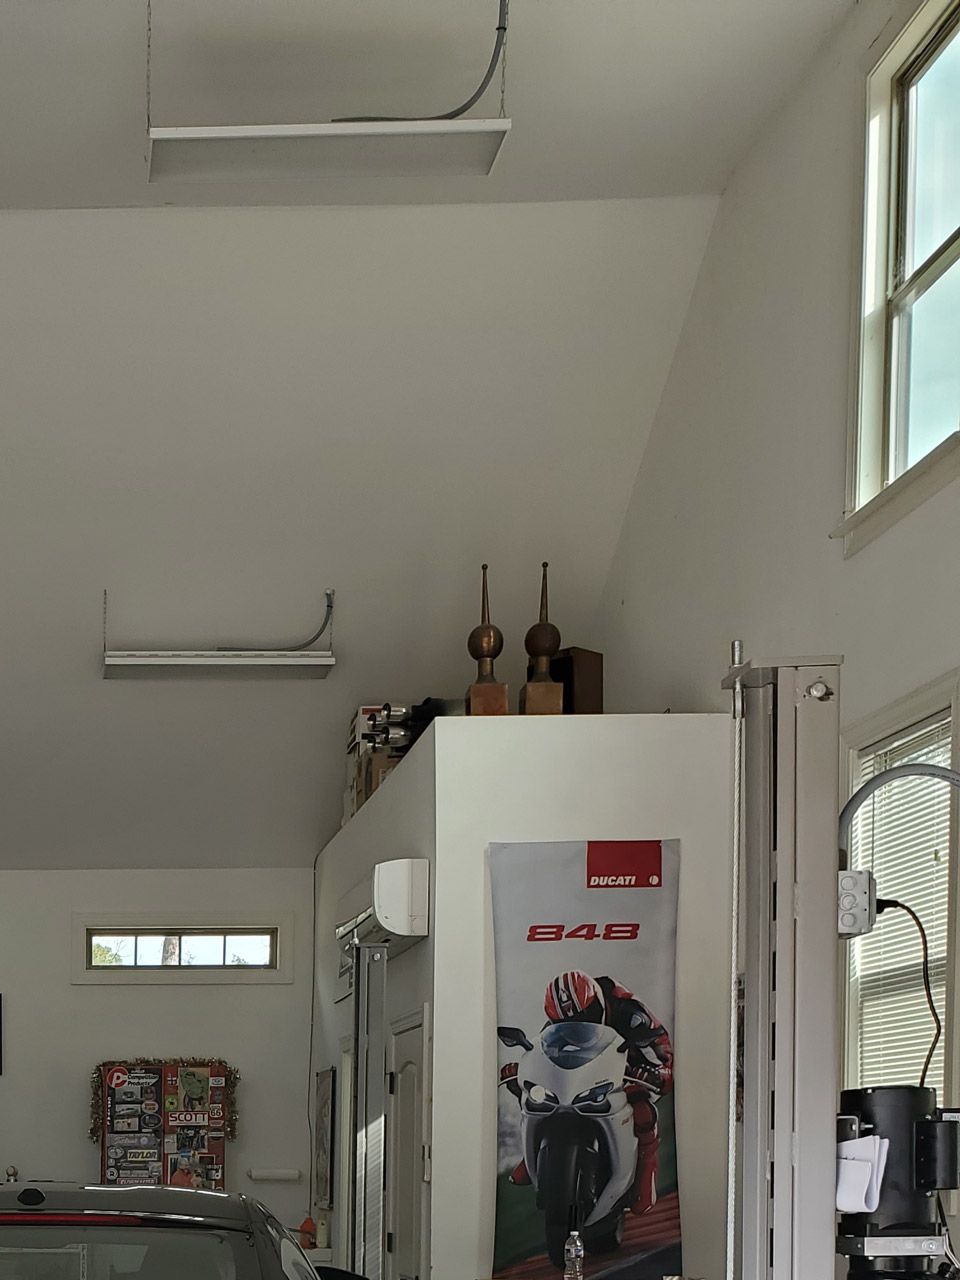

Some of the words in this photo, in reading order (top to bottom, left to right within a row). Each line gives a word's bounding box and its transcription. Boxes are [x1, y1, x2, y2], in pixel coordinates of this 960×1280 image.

[590, 876, 636, 885] DUCATI
[527, 923, 640, 941] 848
[169, 1112, 207, 1121] SCOTT
[128, 1151, 157, 1159] TAYLOR
